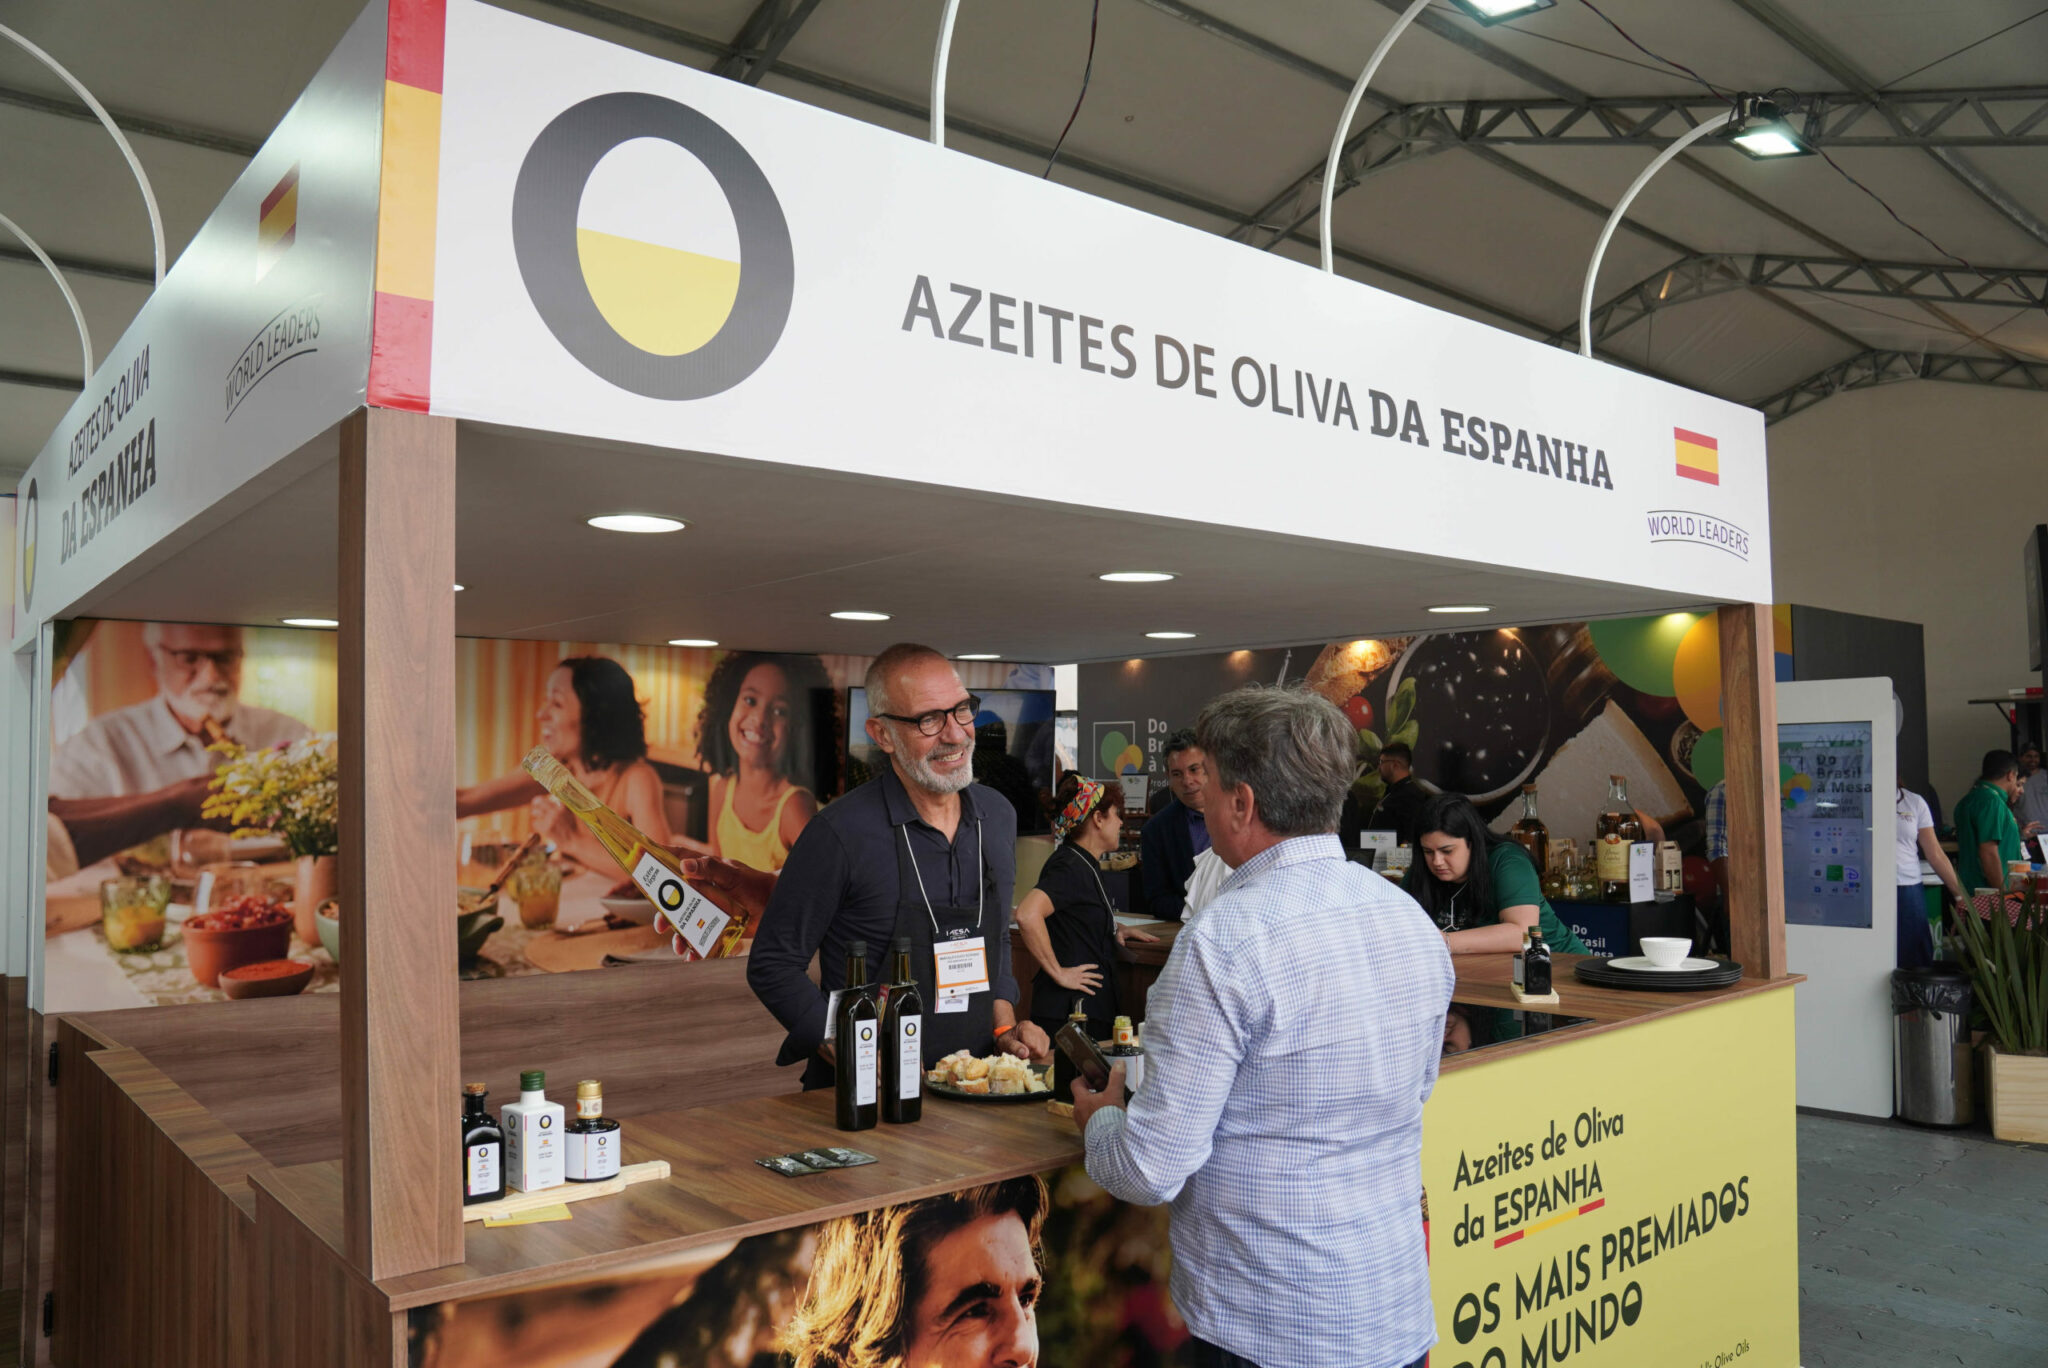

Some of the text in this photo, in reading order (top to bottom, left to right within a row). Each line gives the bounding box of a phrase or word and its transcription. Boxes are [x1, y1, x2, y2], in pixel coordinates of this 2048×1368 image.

[225, 306, 321, 411] WORLD LEADERS
[901, 274, 1614, 491] AZEITES DE OLIVA DA ESPANHA
[68, 344, 150, 481] AZEITES DE OLIVA
[60, 417, 157, 565] DA ESPANHA
[1648, 515, 1749, 555] WORLD LEADERS
[1148, 718, 1168, 734] Do
[1816, 754, 1836, 766] Do
[1816, 766, 1862, 779] Brasil
[1832, 781, 1872, 793] Mesa
[1572, 924, 1588, 935] Do
[1580, 938, 1606, 948] rasil
[1453, 1106, 1625, 1192] Azeites de Oliva
[1453, 1160, 1604, 1248] da ESPANHA
[1452, 1175, 1750, 1345] OS MAIS PREMIADOS
[1521, 1281, 1644, 1368] MUNDO
[1714, 1338, 1750, 1368] Olive Oils
